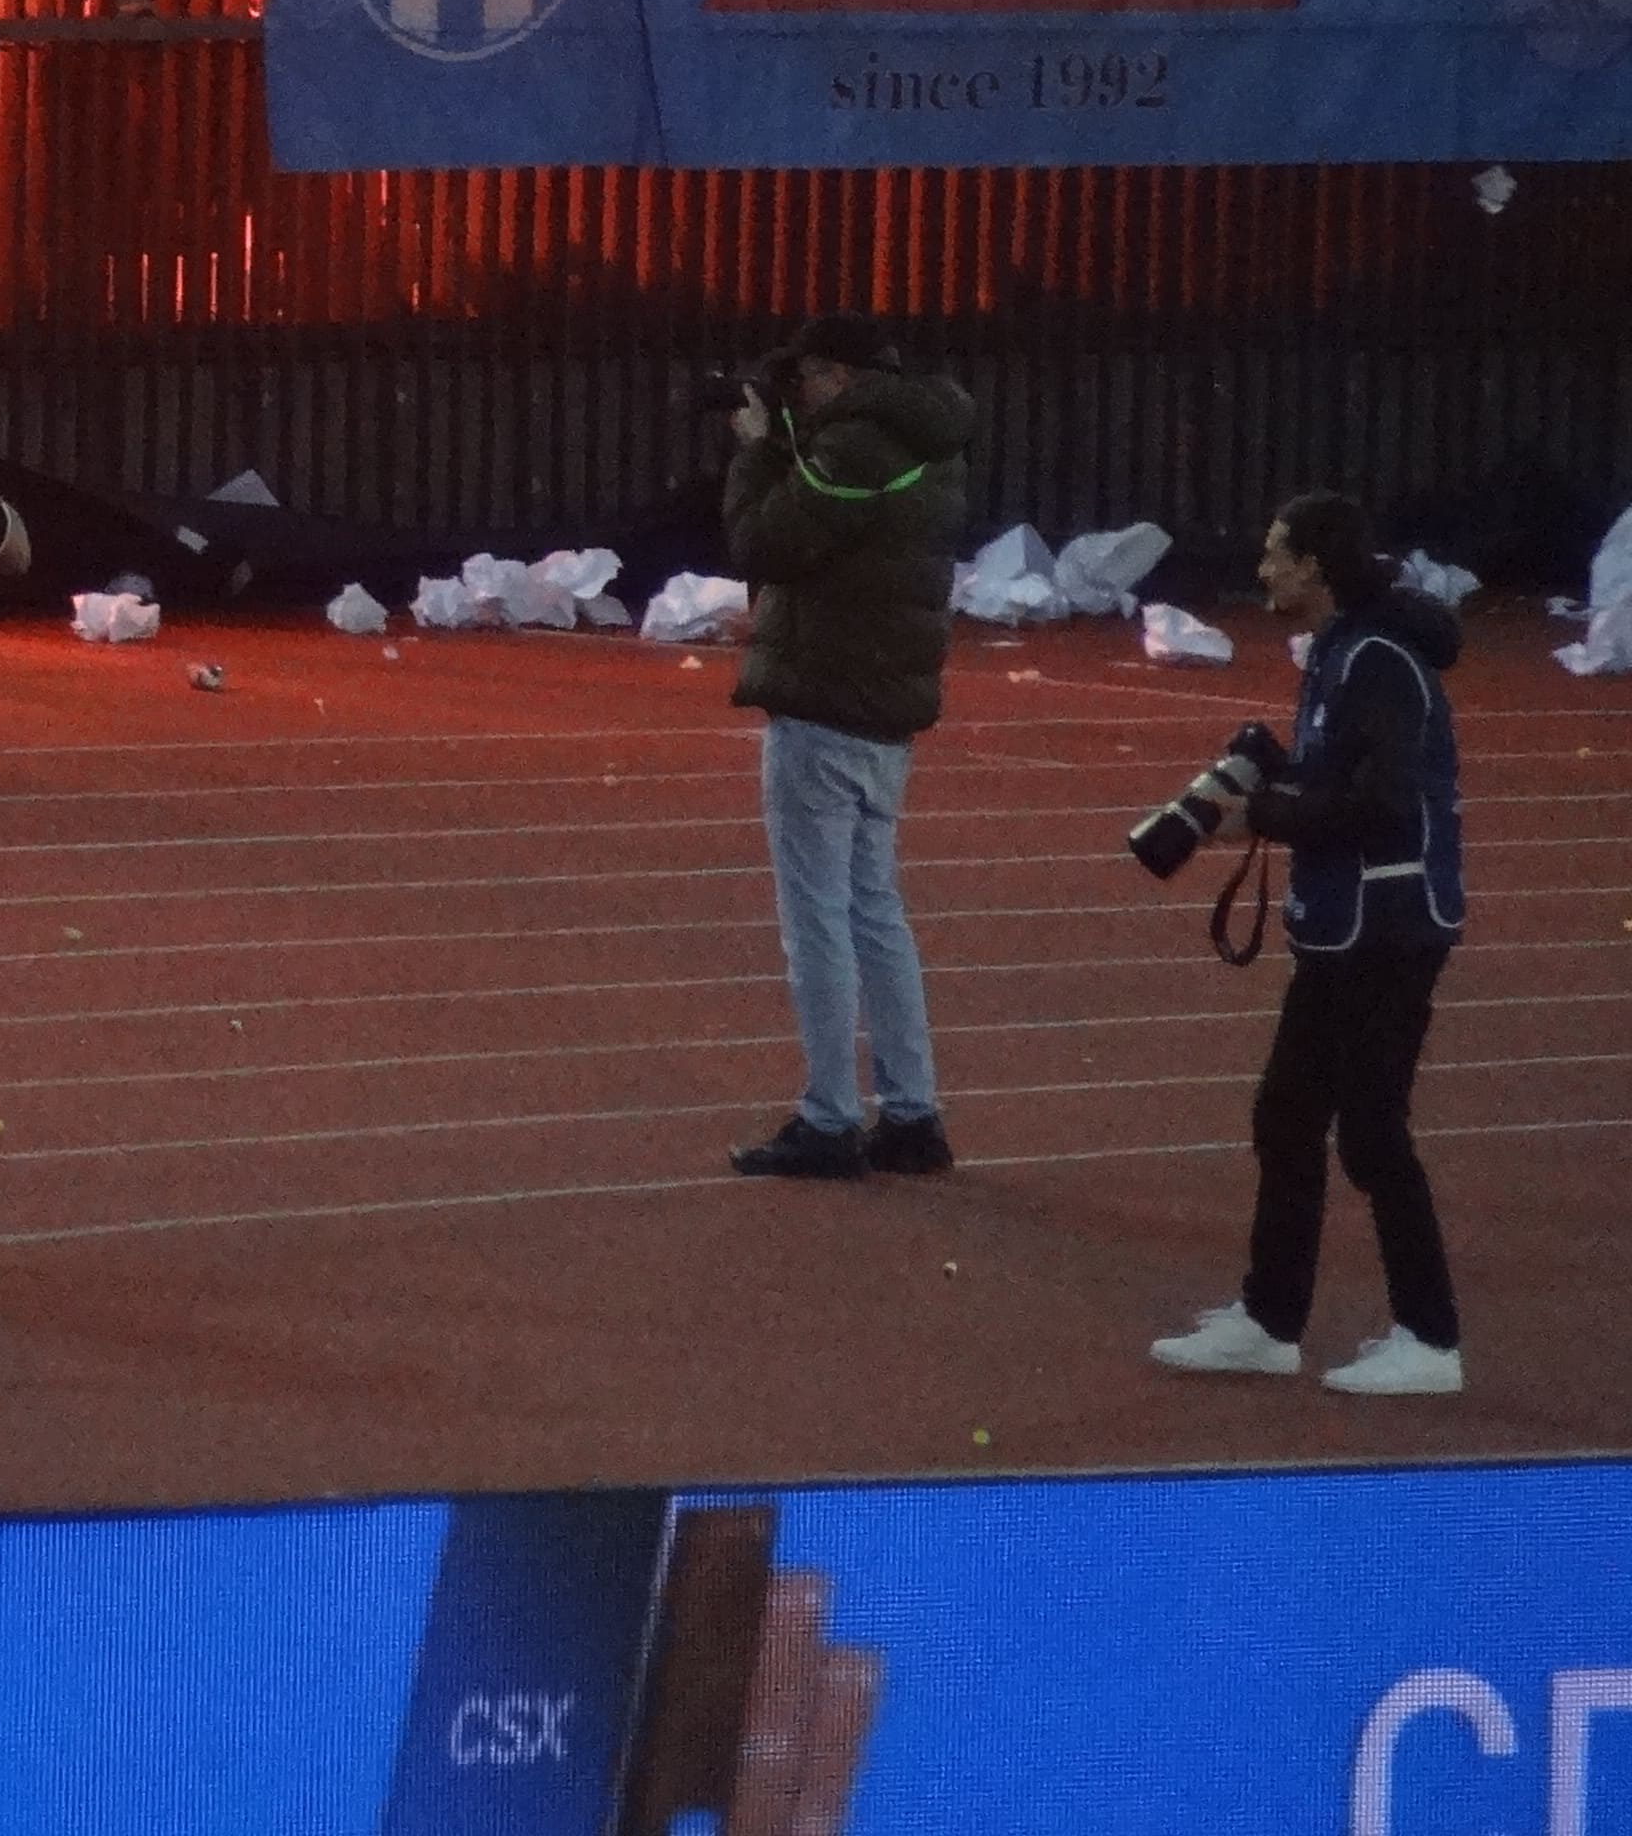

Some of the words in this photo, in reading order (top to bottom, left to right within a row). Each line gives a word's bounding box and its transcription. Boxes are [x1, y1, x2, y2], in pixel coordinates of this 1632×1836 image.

[828, 50, 1001, 112] since
[1028, 52, 1170, 112] 1992
[449, 1688, 577, 1766] CSX
